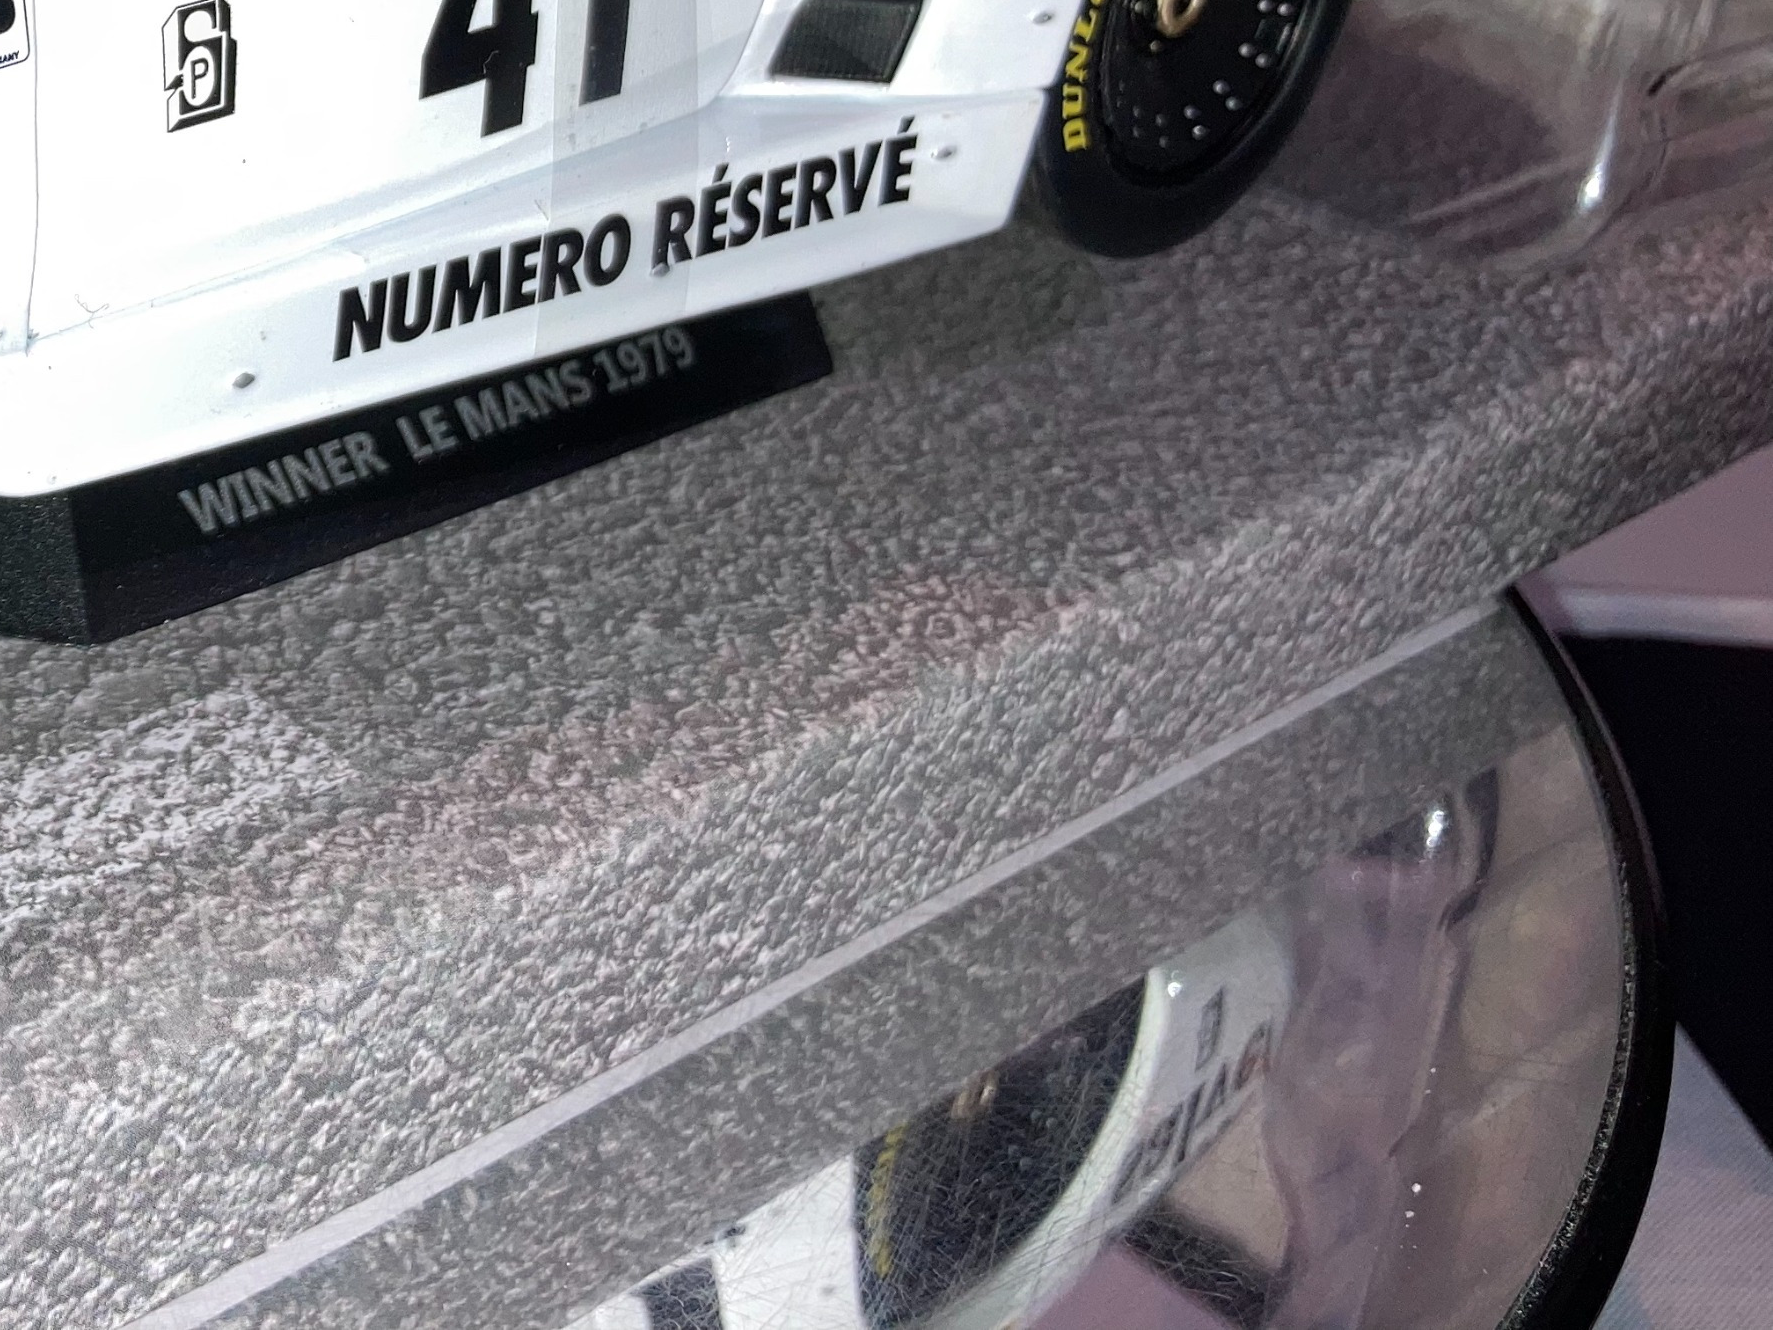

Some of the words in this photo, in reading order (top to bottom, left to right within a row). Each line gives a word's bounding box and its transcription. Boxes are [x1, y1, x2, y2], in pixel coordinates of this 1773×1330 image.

[333, 212, 633, 362] NUMERO
[650, 116, 919, 270] RÉSERVÉ
[177, 430, 391, 536] WINNER
[395, 405, 460, 461] LE
[453, 361, 592, 441] MANS
[590, 326, 696, 394] 1979
